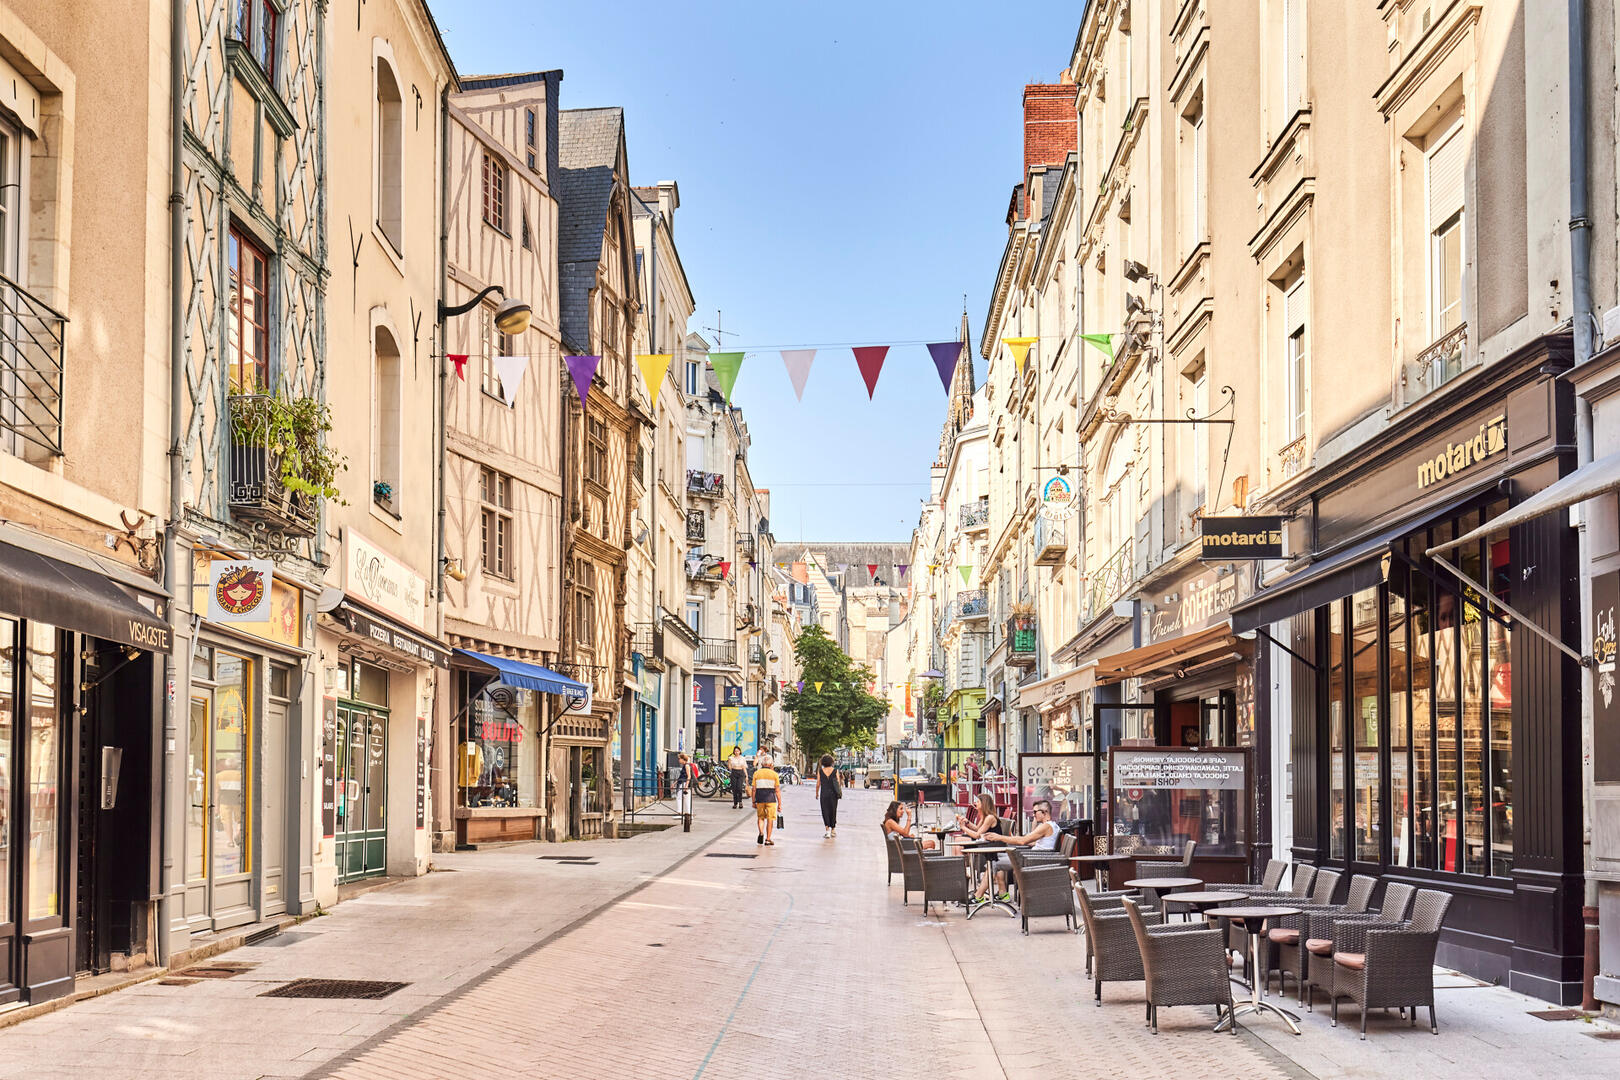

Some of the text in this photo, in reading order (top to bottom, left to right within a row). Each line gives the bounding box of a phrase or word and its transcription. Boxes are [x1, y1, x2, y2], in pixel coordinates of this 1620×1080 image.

[1417, 424, 1486, 489] motard
[1202, 530, 1267, 546] motard
[217, 586, 264, 613] MADAME CHOCOLAT
[1182, 582, 1220, 628] COFFEE
[1220, 589, 1236, 612] SHOP
[128, 620, 169, 649] VISAGISTE
[481, 721, 523, 743] SOLDES
[1158, 778, 1180, 786] SHOP
